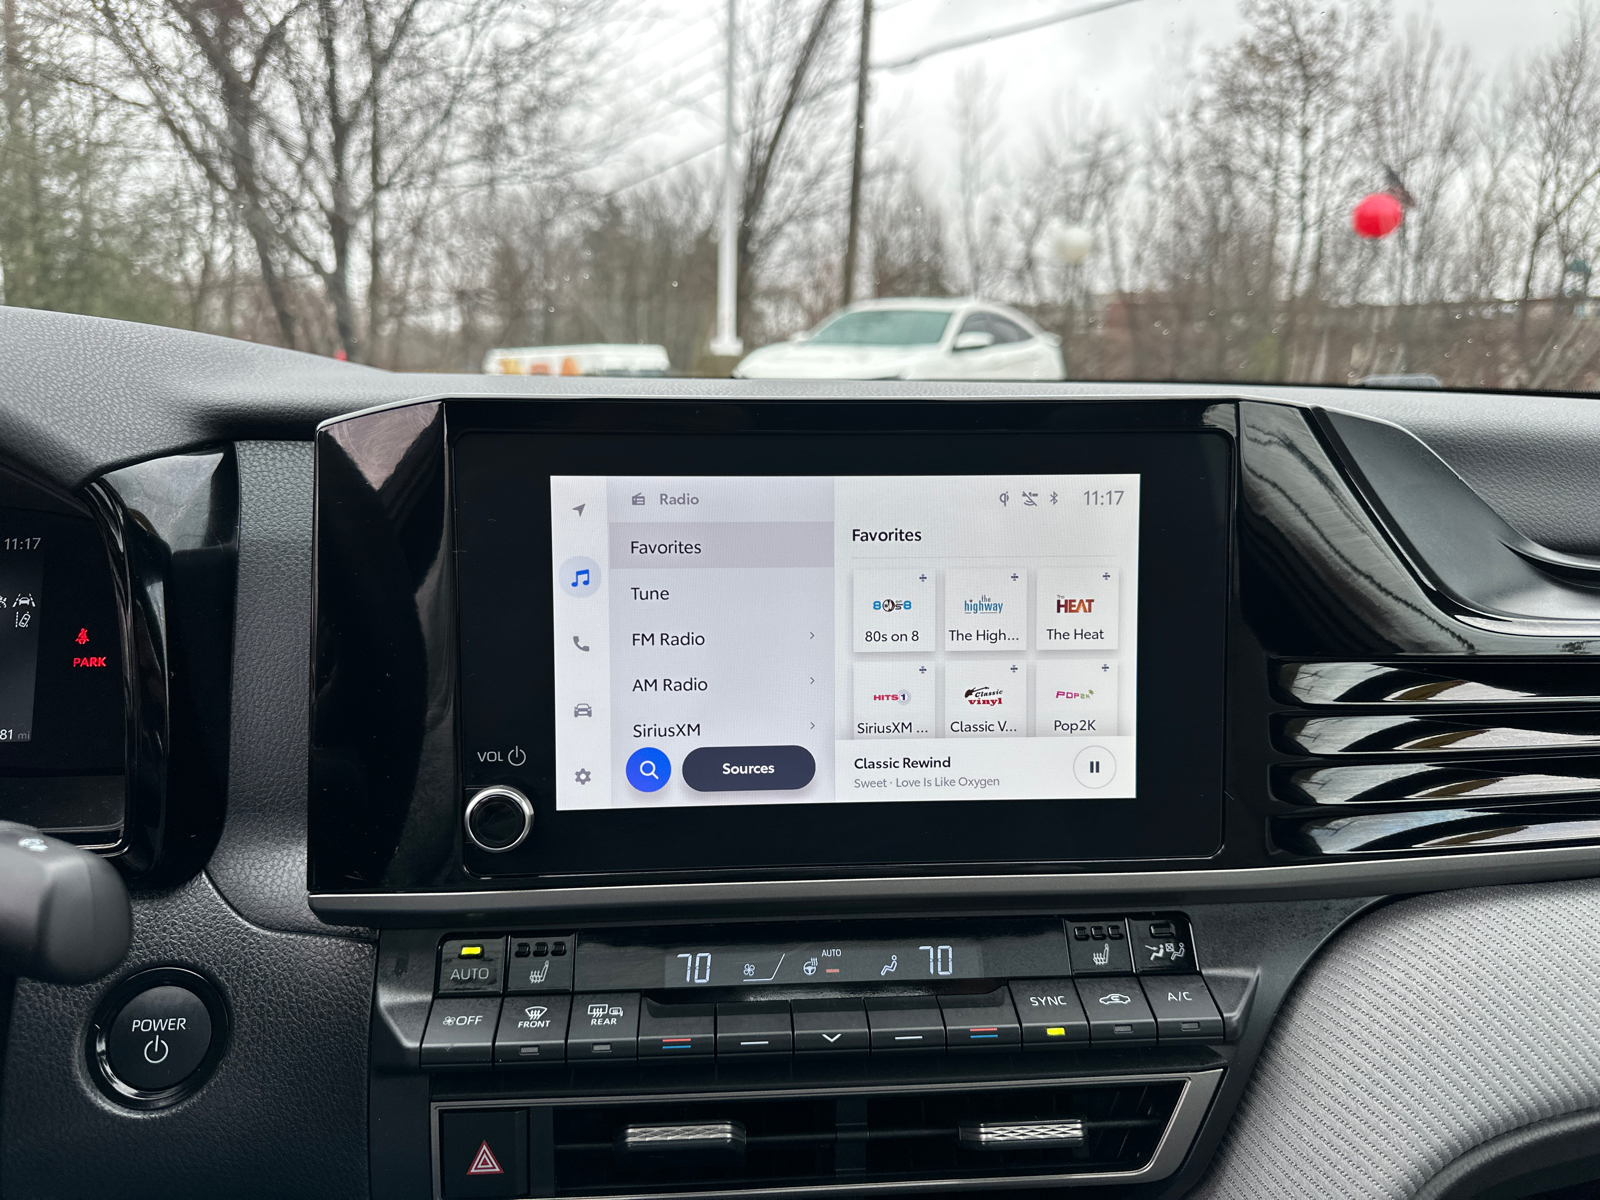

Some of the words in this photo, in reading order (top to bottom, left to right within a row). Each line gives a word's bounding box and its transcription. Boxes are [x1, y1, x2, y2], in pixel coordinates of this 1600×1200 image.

[660, 493, 699, 505] Radio
[1084, 490, 1124, 505] 11:17
[852, 528, 922, 541] Favorites
[4, 537, 41, 550] 11:17
[630, 541, 701, 554] Favorites
[630, 587, 670, 600] Tune
[964, 599, 1003, 614] highway
[1056, 599, 1094, 613] HEAT
[632, 634, 654, 646] FM
[660, 632, 705, 645] Radio
[865, 630, 888, 642] 80s
[891, 633, 908, 642] on
[911, 630, 919, 642] 8
[949, 629, 972, 641] The
[976, 629, 1019, 644] High...
[1046, 629, 1070, 640] The
[1074, 628, 1104, 640] Heat
[73, 657, 107, 667] PARK
[632, 679, 658, 692] AM
[663, 677, 708, 691] Radio
[968, 697, 1003, 706] vinyl
[633, 724, 701, 738] SiriusXM
[857, 722, 913, 734] SiriusXM
[950, 720, 995, 733] Classic
[997, 720, 1017, 732] V...
[1054, 719, 1096, 734] Pop2K
[17, 730, 30, 740] mi
[477, 751, 504, 762] VOL
[854, 758, 900, 769] Classic
[903, 756, 951, 769] Rewind
[722, 762, 775, 775] Sources
[854, 777, 888, 788] Sweet
[896, 777, 921, 787] Love
[923, 777, 933, 787] Is
[934, 776, 956, 787] Like
[958, 776, 1000, 790] Oxygen
[821, 948, 842, 957] AUTO
[919, 945, 953, 976] 70
[450, 967, 490, 980] AUTO
[677, 952, 711, 983] 70
[1029, 995, 1067, 1007] SYNC
[1167, 991, 1193, 1002] A/C
[131, 1017, 187, 1032] POWER
[456, 1015, 483, 1026] OFF
[517, 1020, 551, 1028] FRONT
[590, 1018, 618, 1026] REAR
